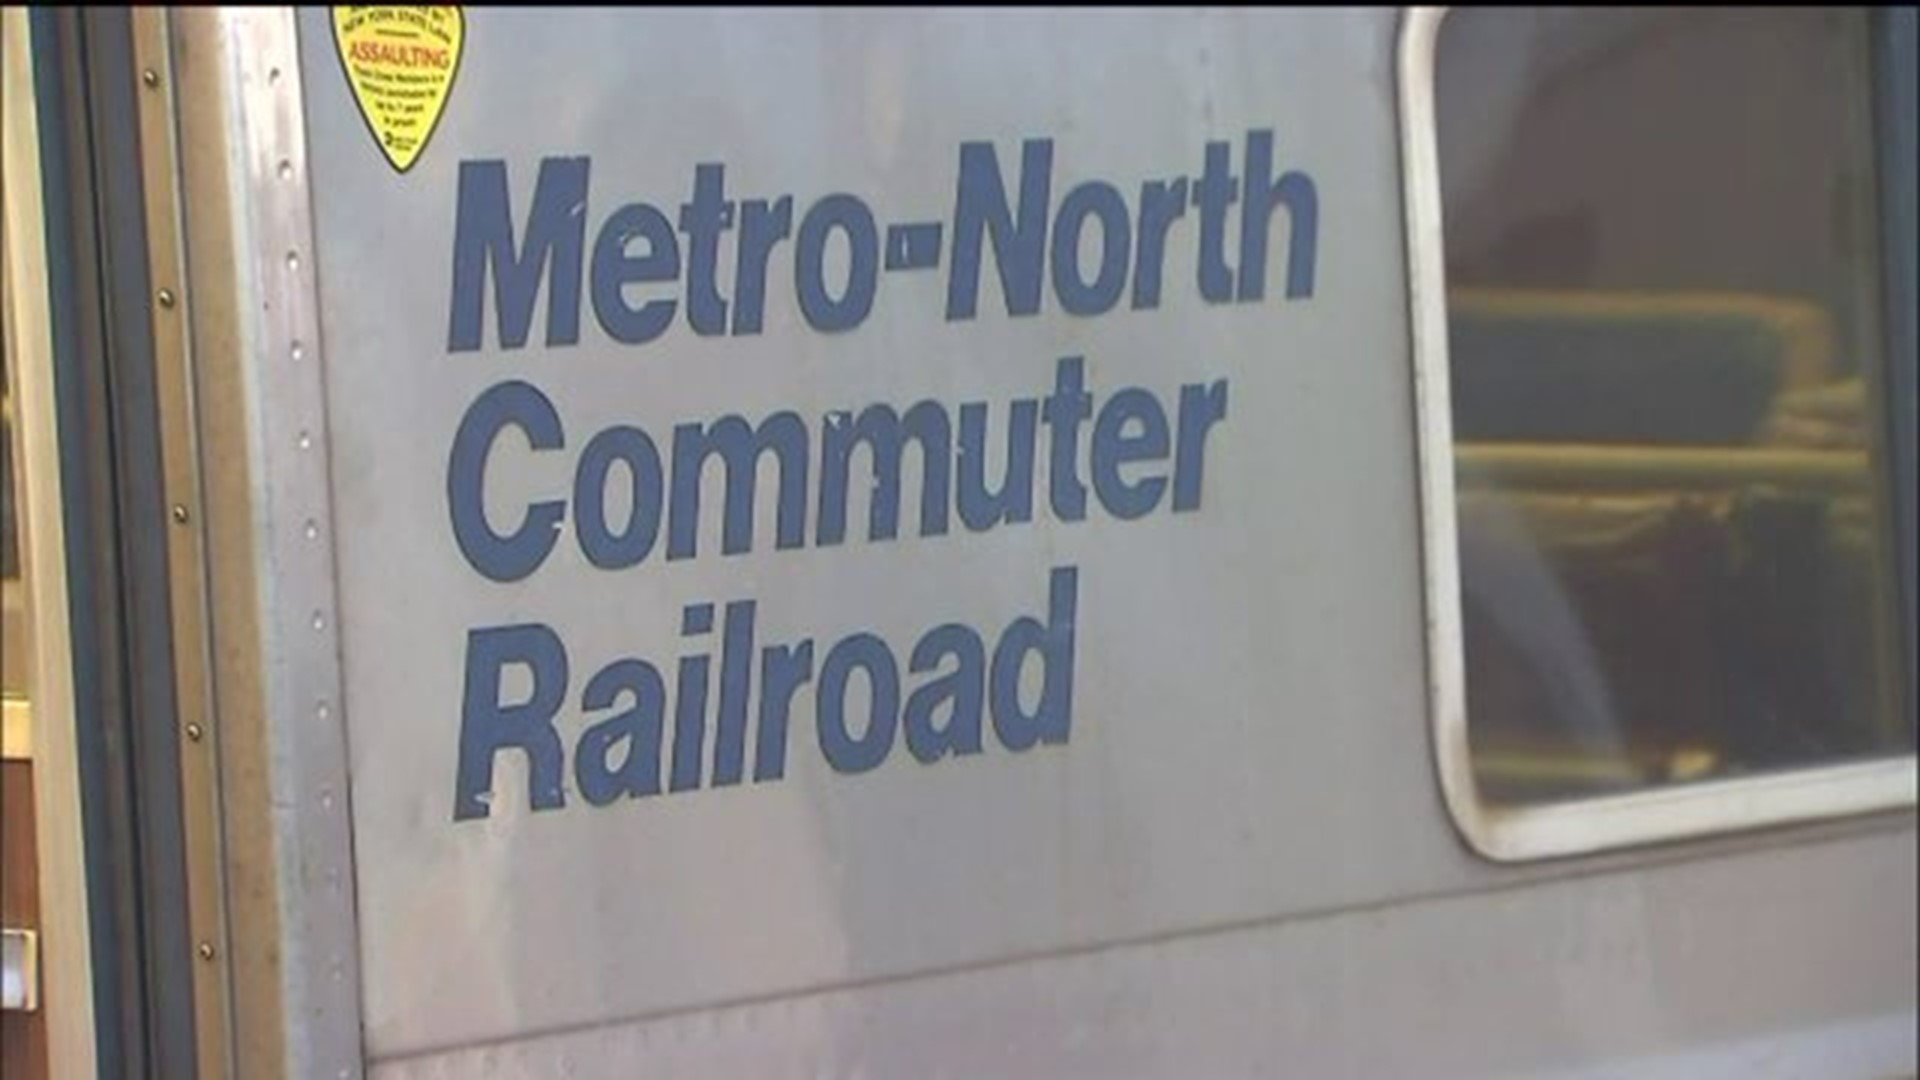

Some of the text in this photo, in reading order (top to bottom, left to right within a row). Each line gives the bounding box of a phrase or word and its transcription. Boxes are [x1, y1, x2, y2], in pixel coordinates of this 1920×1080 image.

[349, 41, 450, 70] ASSAULTING
[447, 129, 1319, 352] Metro-North
[447, 356, 1228, 582] Commuter
[452, 565, 1078, 821] Railroad
